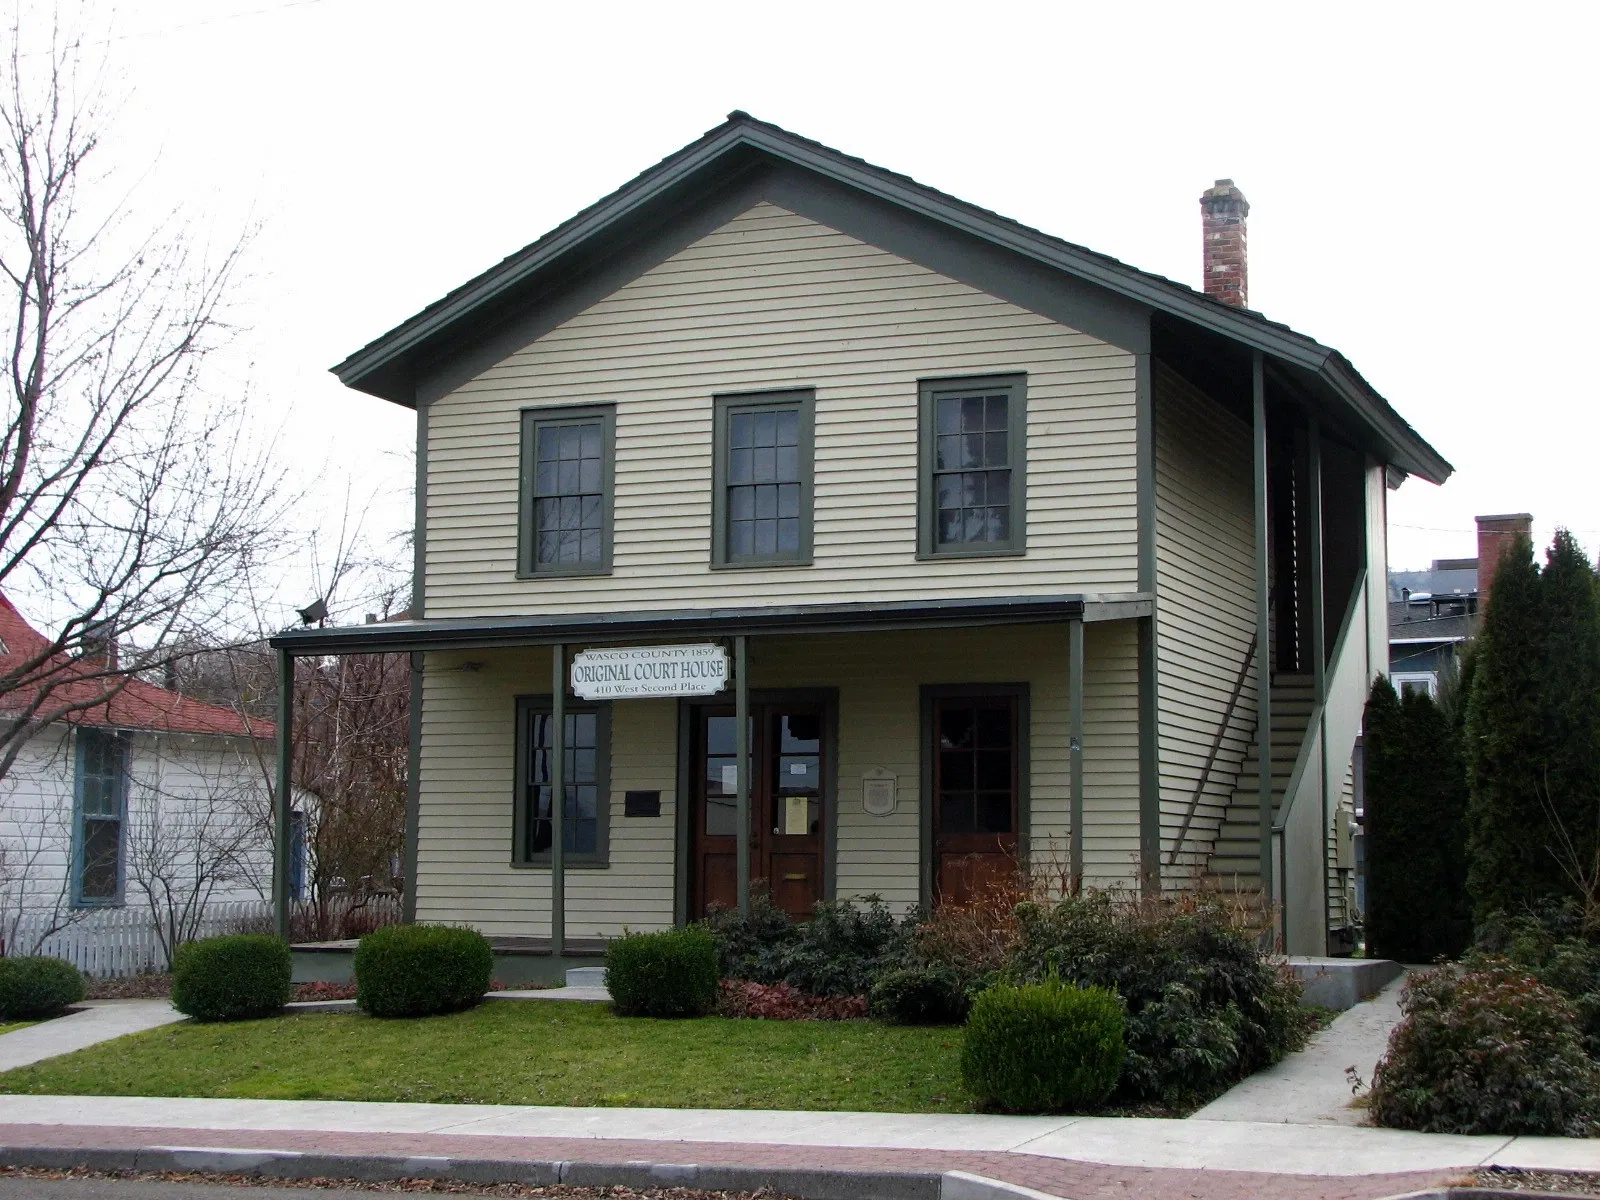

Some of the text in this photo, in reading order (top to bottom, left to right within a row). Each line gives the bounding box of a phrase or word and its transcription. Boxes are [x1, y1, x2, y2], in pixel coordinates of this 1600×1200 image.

[585, 648, 715, 661] WASCO COUNTY 1859
[574, 660, 724, 683] ORIGINAL COURT HOUSE
[593, 682, 707, 694] 410 West Second Place
